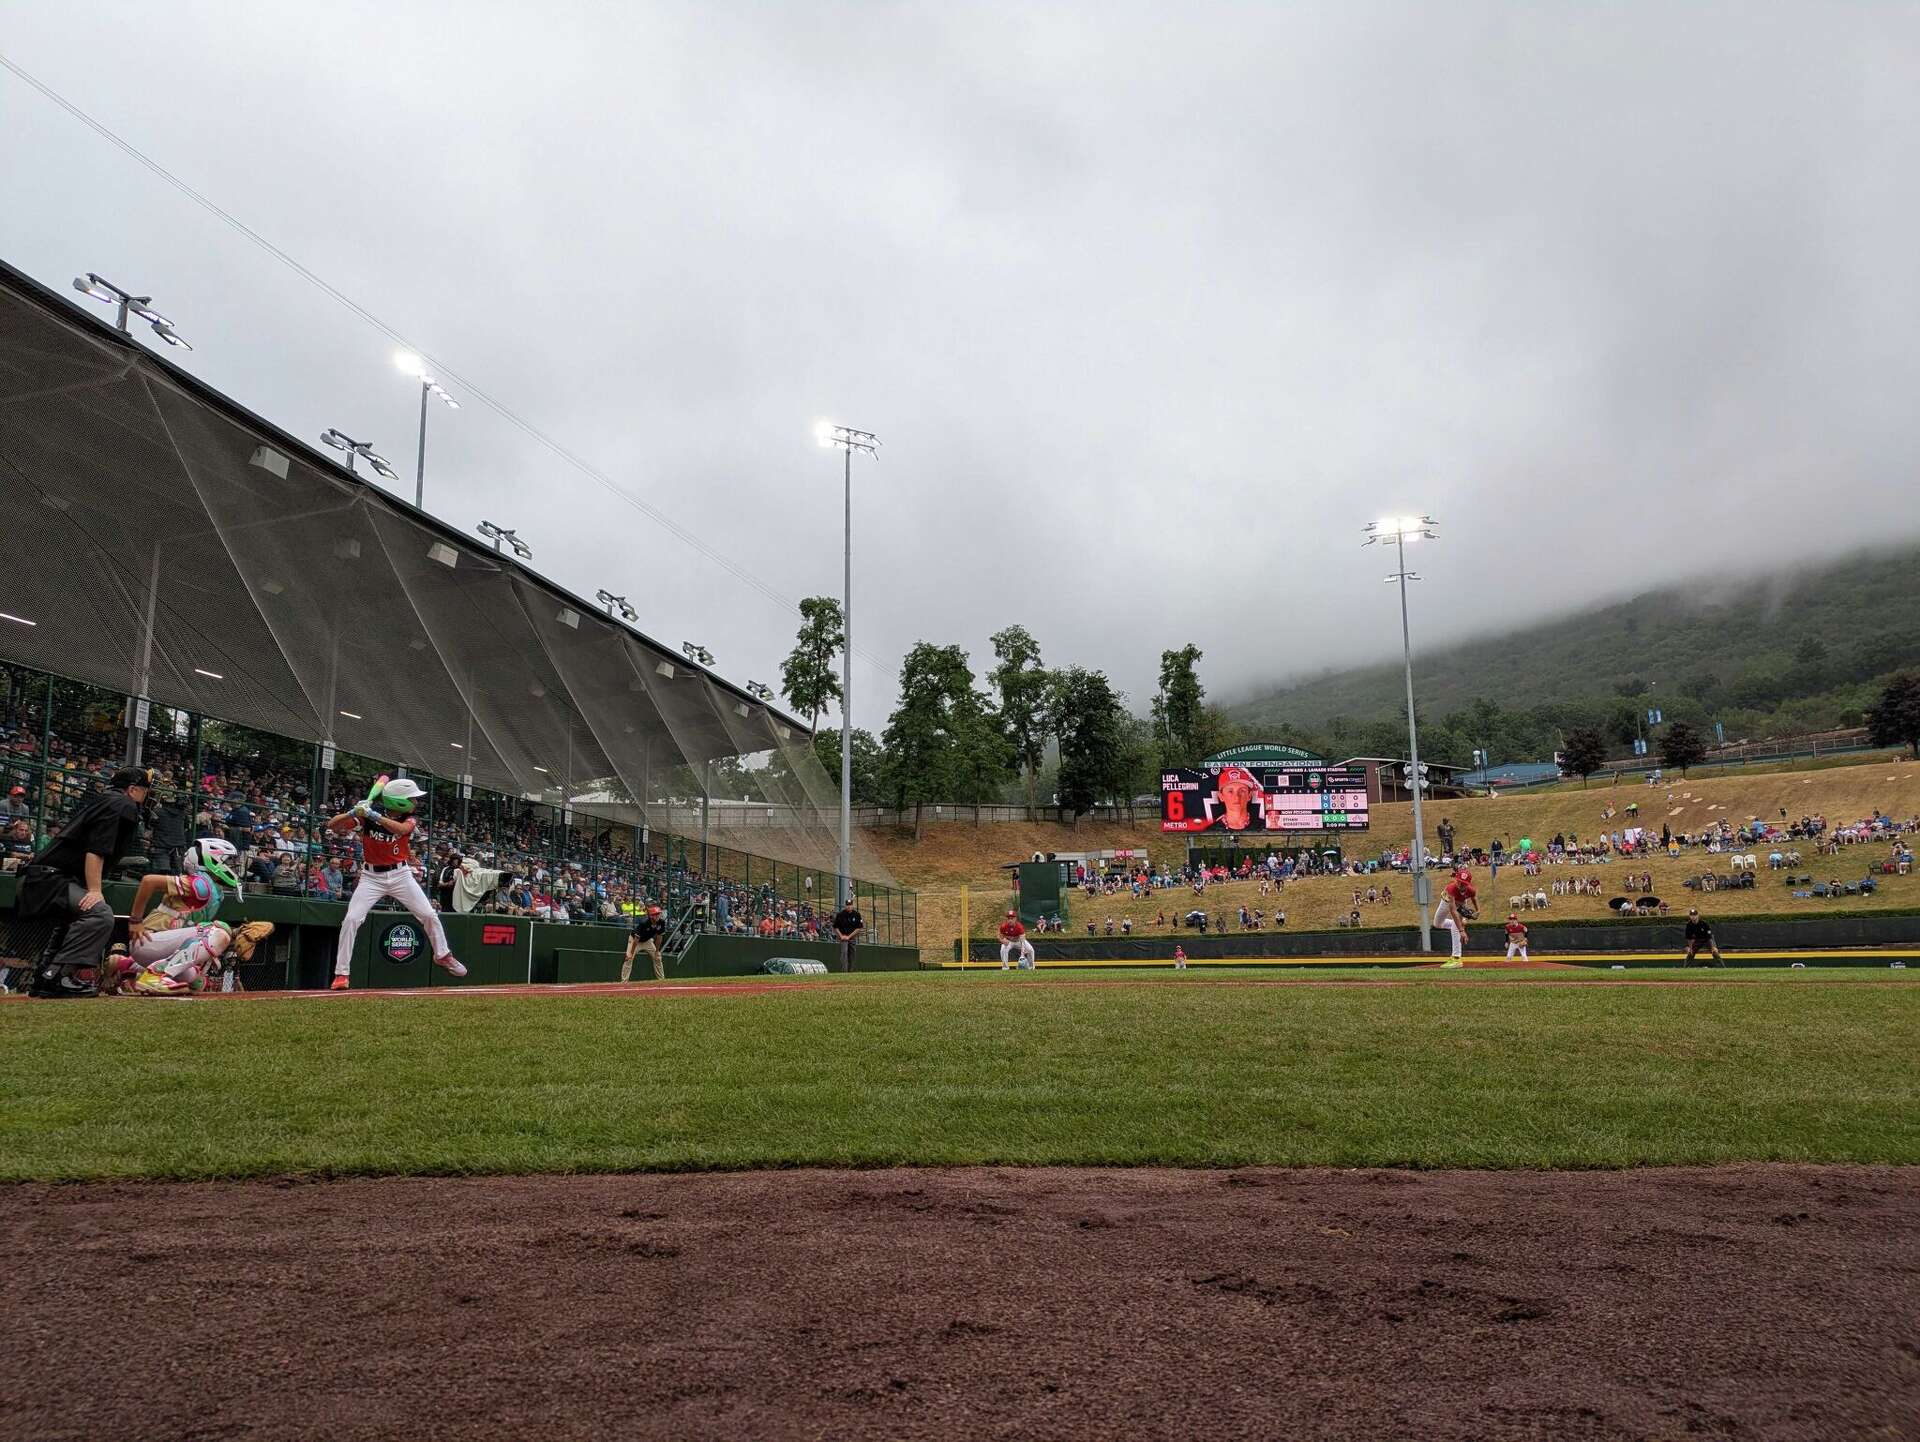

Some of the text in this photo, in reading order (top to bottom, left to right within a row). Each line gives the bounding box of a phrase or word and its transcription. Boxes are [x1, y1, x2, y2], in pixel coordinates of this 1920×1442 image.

[1216, 744, 1309, 760] LITTLE LEAGUE WORLD SERIES
[1162, 774, 1179, 782] LUCA
[1162, 782, 1198, 791] PELLEGRINI
[1168, 791, 1184, 821] 6
[393, 843, 400, 855] 6
[483, 925, 515, 945] ESPN
